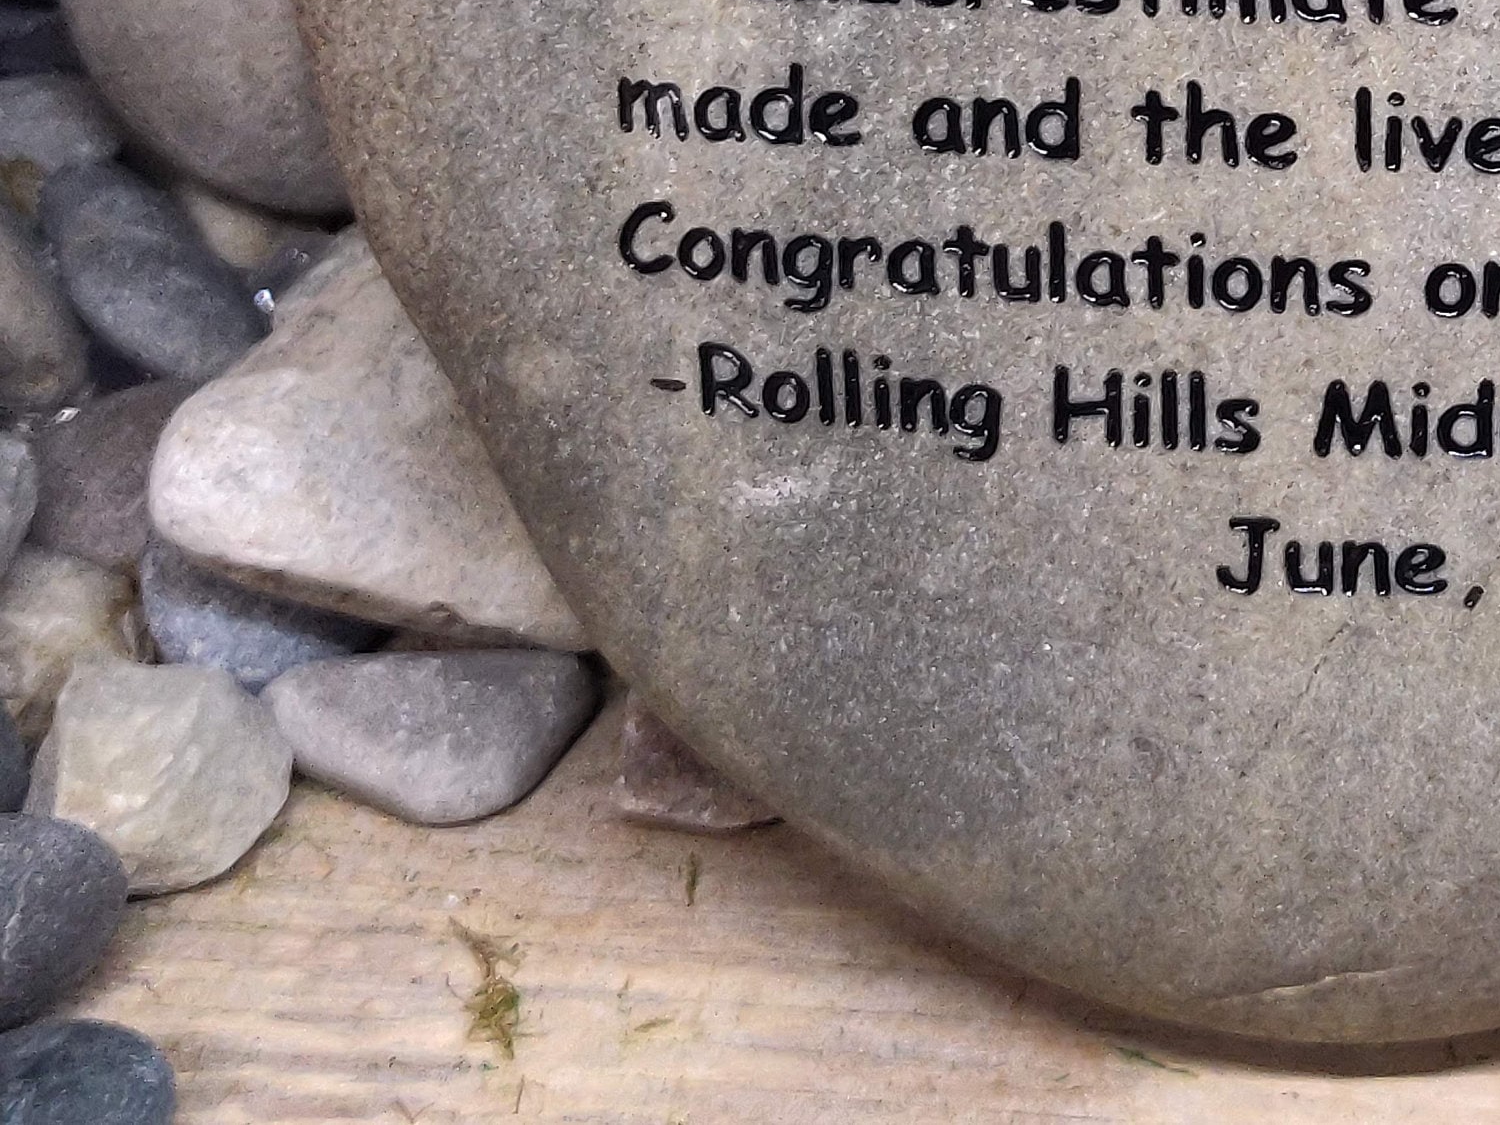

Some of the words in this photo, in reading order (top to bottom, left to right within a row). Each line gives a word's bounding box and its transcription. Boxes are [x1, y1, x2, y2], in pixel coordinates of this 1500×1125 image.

[617, 62, 862, 147] made
[911, 76, 1081, 161] and
[1131, 80, 1298, 170] the
[618, 201, 1372, 317] Congratulations
[649, 341, 1003, 462] -Rolling
[1053, 365, 1261, 455] Hills
[1216, 517, 1485, 609] June,
